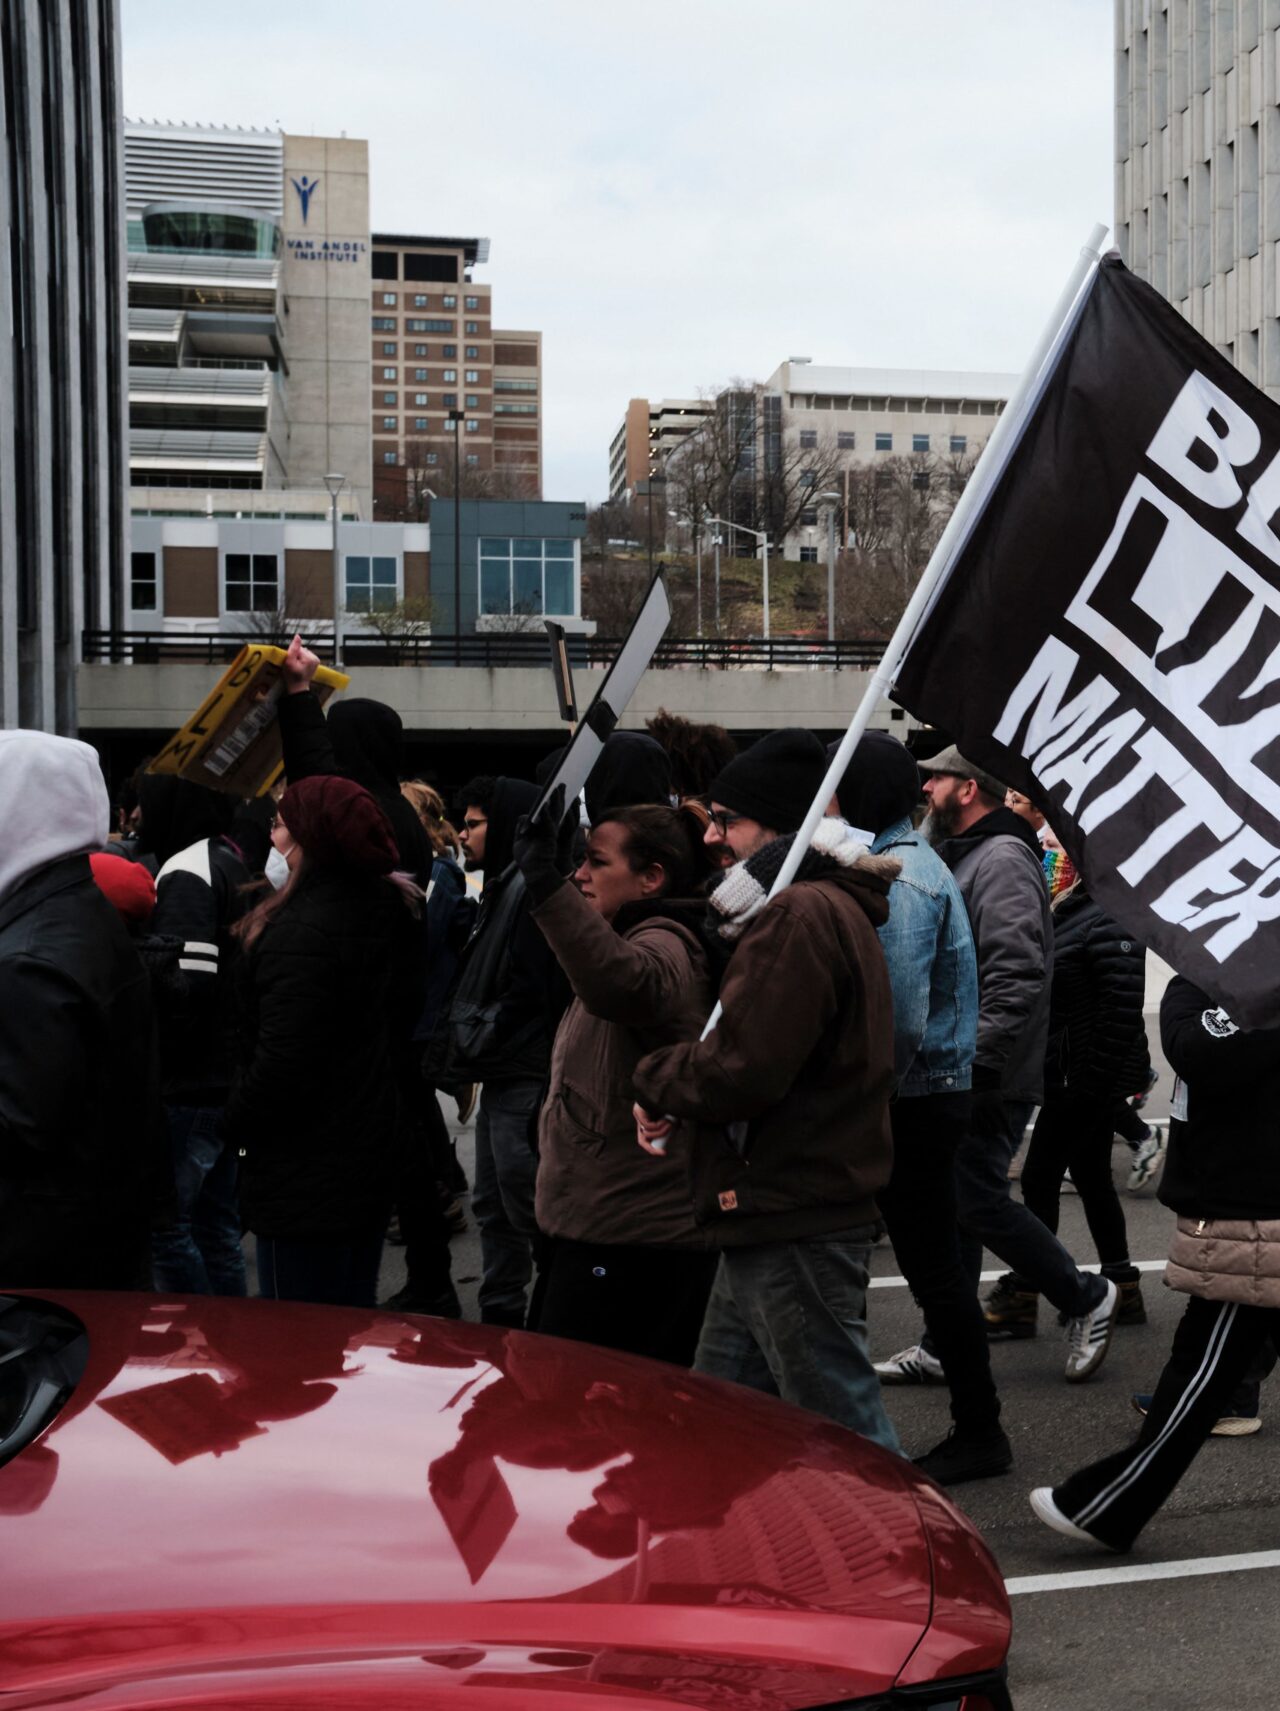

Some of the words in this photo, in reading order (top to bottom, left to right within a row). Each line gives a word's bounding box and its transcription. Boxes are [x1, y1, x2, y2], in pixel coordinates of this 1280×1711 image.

[287, 240, 314, 249] VAN
[322, 241, 366, 252] ANDEL
[294, 251, 358, 262] INSTITUTE
